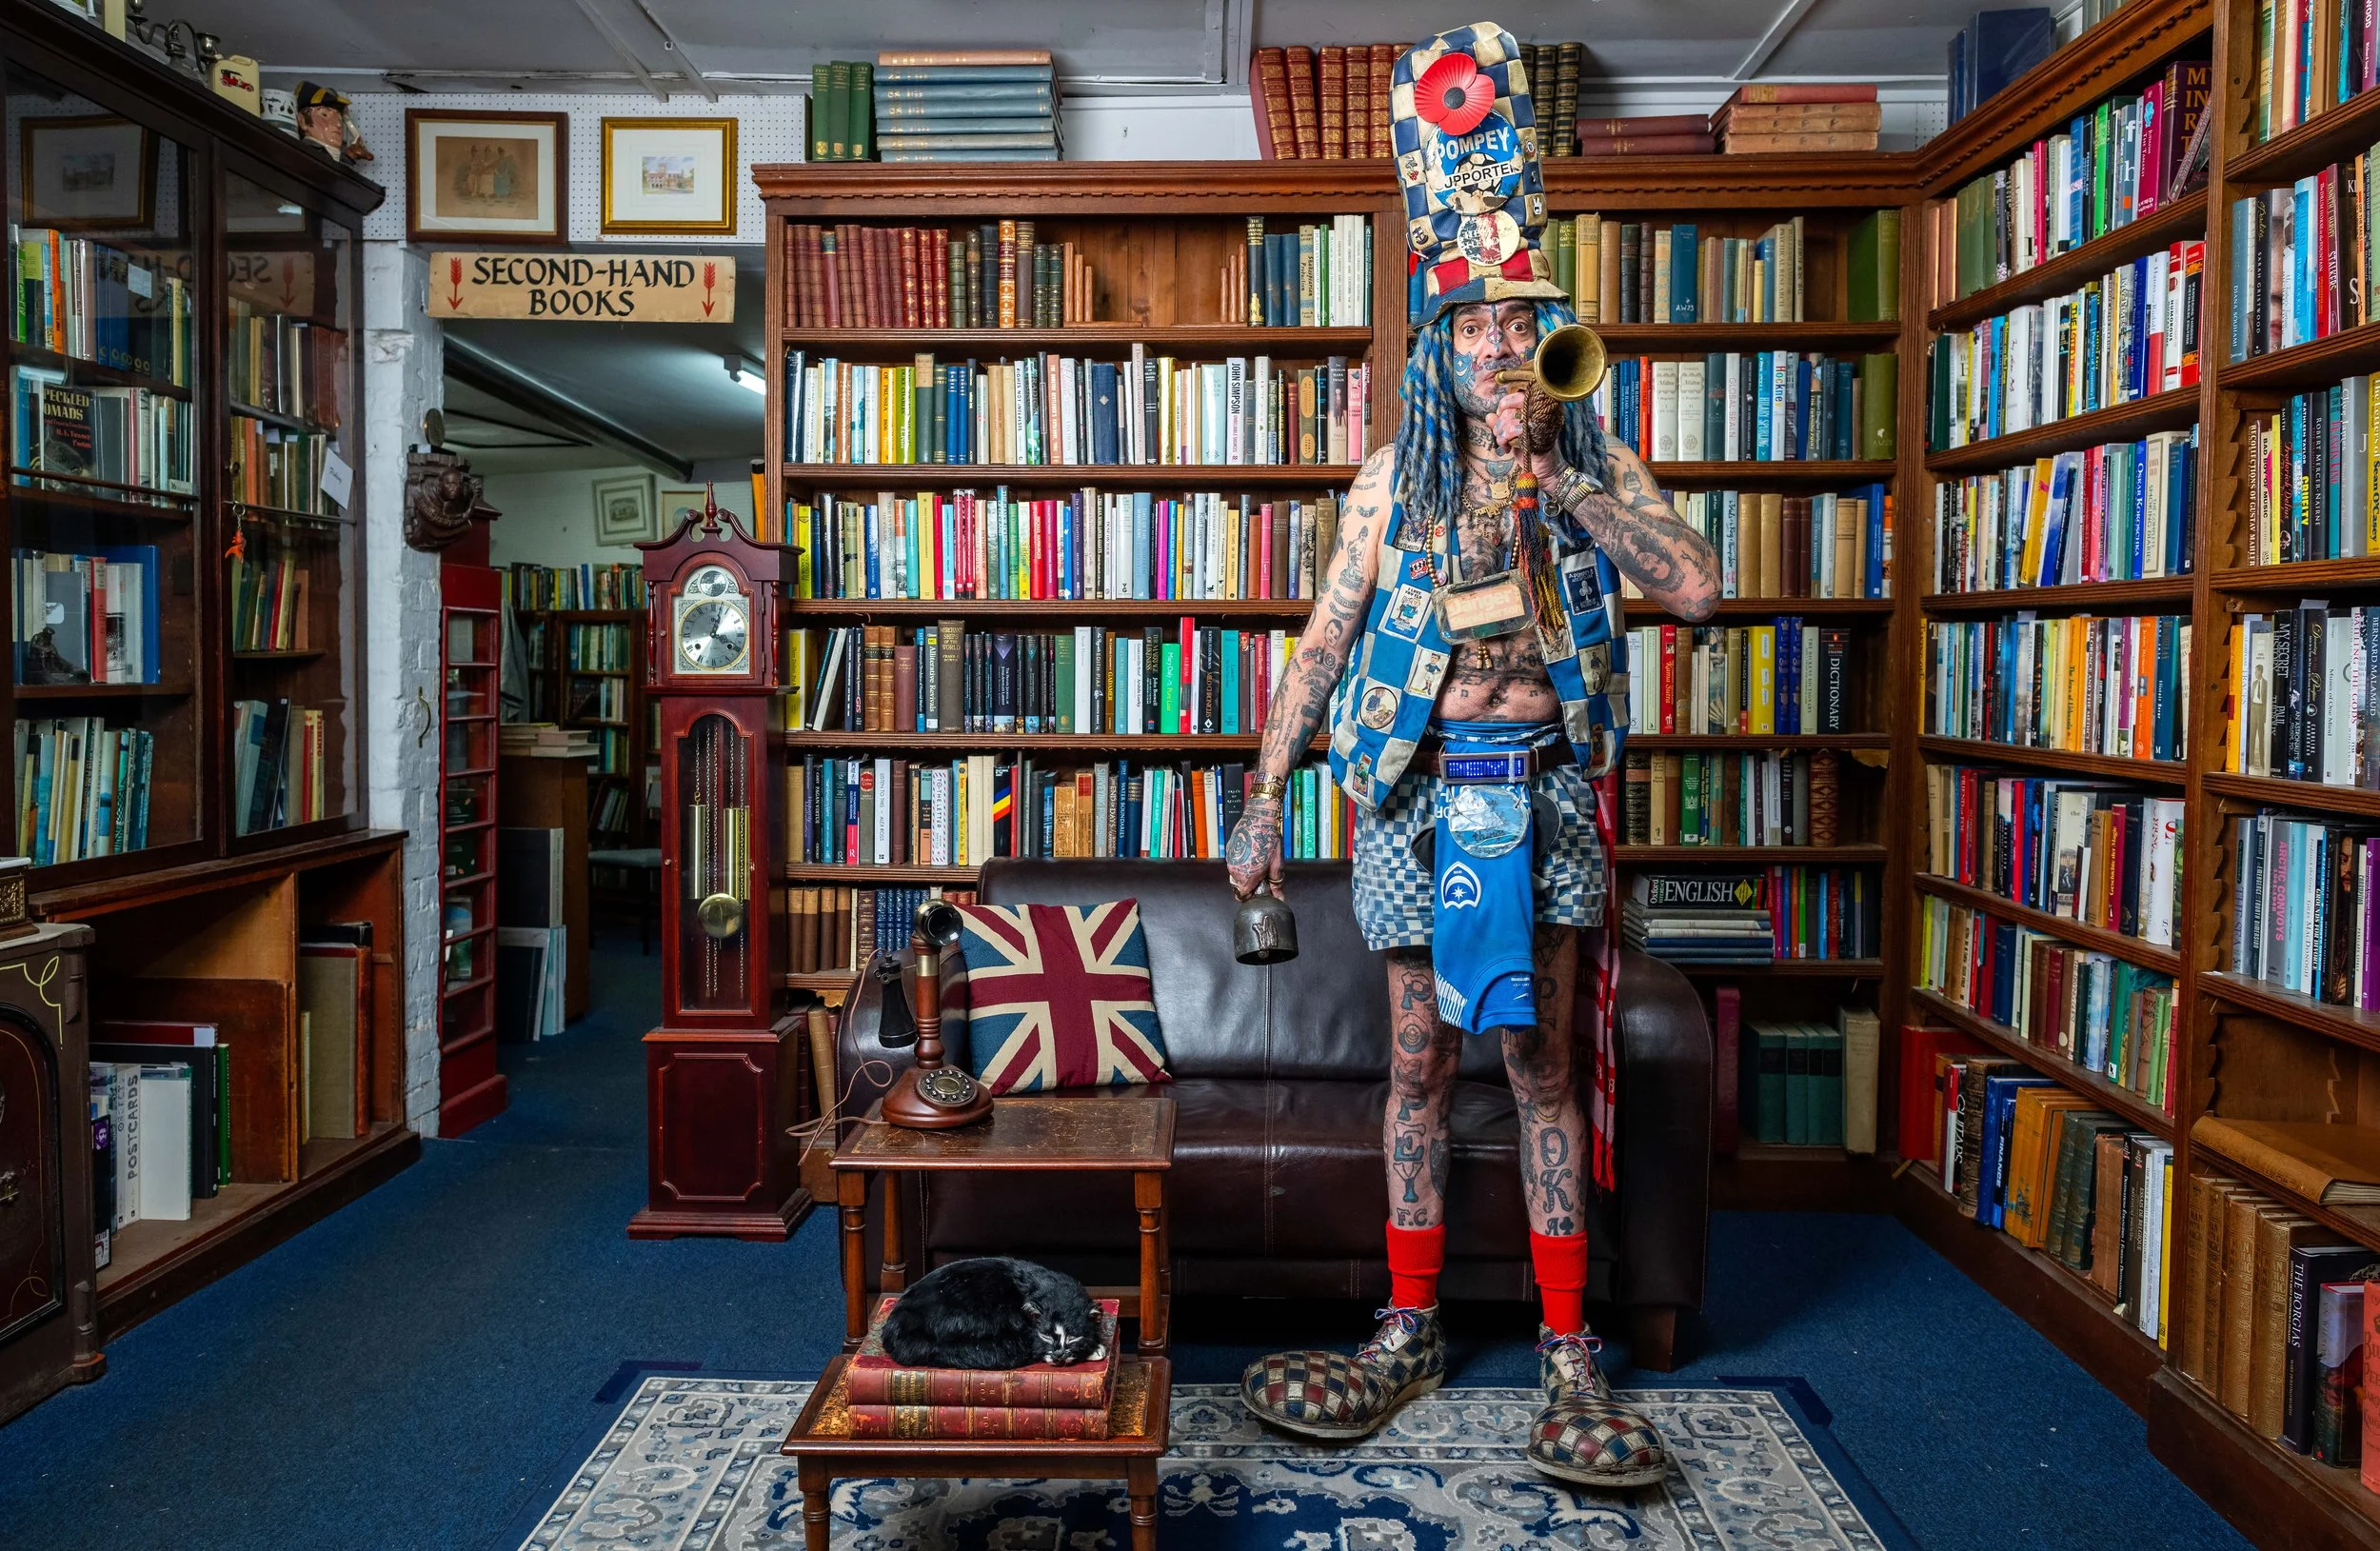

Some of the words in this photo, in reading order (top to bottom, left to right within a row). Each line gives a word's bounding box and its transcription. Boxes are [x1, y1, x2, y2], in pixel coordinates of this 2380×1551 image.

[1438, 127, 1510, 160] POMPEY
[1439, 163, 1520, 190] UPPORTER
[472, 256, 696, 288] SECOND-HAND
[2329, 250, 2337, 290] STALKERS
[528, 288, 636, 317] BOOKS
[2120, 297, 2129, 327] TIMES
[1231, 363, 1240, 381] JOHN
[44, 388, 89, 408] PECKLED
[1231, 382, 1240, 414] SIMPSON
[1728, 377, 1737, 408] GLOBAL
[1775, 366, 1786, 408] Hockney
[2341, 388, 2350, 415] Clive
[44, 402, 84, 421] OMADS
[1759, 397, 1770, 418] HILARY
[1728, 411, 1737, 439] BRAIN
[1759, 419, 1770, 447] SPURLING
[2341, 421, 2350, 450] James
[2330, 421, 2341, 459] FRANCIS
[2284, 441, 2292, 487] Frederick
[2330, 463, 2341, 485] KING
[2371, 461, 2380, 489] Sean
[2136, 463, 2145, 495] OSKAR
[2263, 478, 2269, 488] OF
[2250, 490, 2256, 502] OF
[2284, 488, 2292, 519] Delius
[2134, 498, 2144, 557] KOKOSCHKA
[2370, 492, 2380, 542] O'Casey
[1290, 527, 1299, 559] Temptress
[2145, 529, 2153, 564] DIARIES
[2278, 623, 2290, 641] MY
[2370, 617, 2379, 662] BERNARD
[1664, 661, 1673, 682] Kama
[2278, 643, 2290, 678] SECRET
[1664, 683, 1673, 704] Sutra
[1829, 658, 1841, 729] DICTIONARY
[2370, 665, 2378, 716] MALAMUD
[2276, 706, 2286, 726] PAUL
[2294, 709, 2301, 720] AN
[1097, 768, 1106, 806] SURVEYING
[1305, 800, 1315, 820] TEXT
[1305, 820, 1315, 832] AND
[1305, 831, 1315, 855] VOICE
[2277, 841, 2288, 882] ARCTIC
[1650, 879, 1659, 905] Oxford
[1664, 881, 1735, 903] ENGLISH
[2275, 885, 2287, 942] CONVOYS
[127, 1075, 138, 1181] POSTCARDS
[1954, 1093, 1966, 1164] GUITARS
[1995, 1136, 2004, 1187] FINANCE
[1397, 1208, 1433, 1226] F.C.
[2294, 1263, 2305, 1289] THE
[2291, 1291, 2303, 1346] BORGIAS
